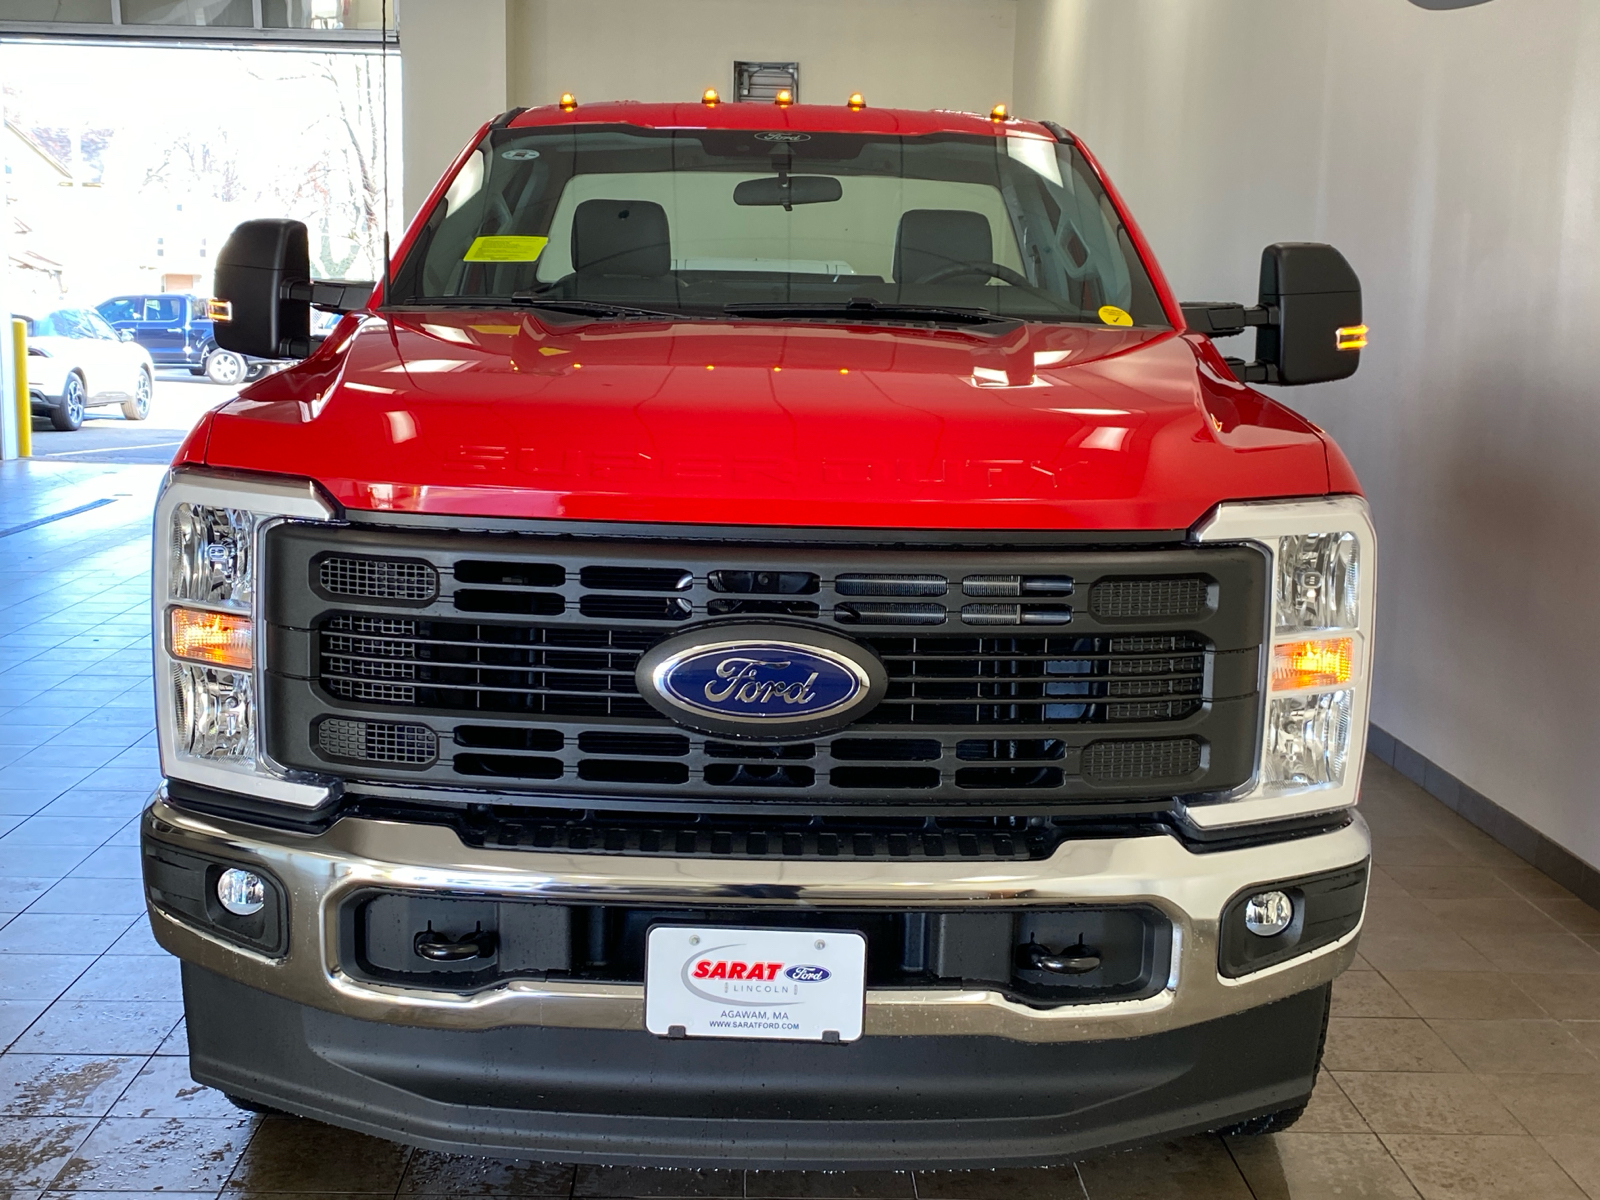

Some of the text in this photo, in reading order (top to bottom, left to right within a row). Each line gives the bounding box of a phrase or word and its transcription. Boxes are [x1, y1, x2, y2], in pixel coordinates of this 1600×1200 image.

[764, 132, 801, 141] Ford
[442, 443, 1090, 489] SUPER DUTY
[704, 657, 819, 703] Ford
[692, 959, 823, 982] SARAT Ford
[733, 984, 789, 993] LINCOLN
[720, 1010, 789, 1020] AGAWAM, MA
[709, 1020, 800, 1030] WWW.SARATFORD.COM
